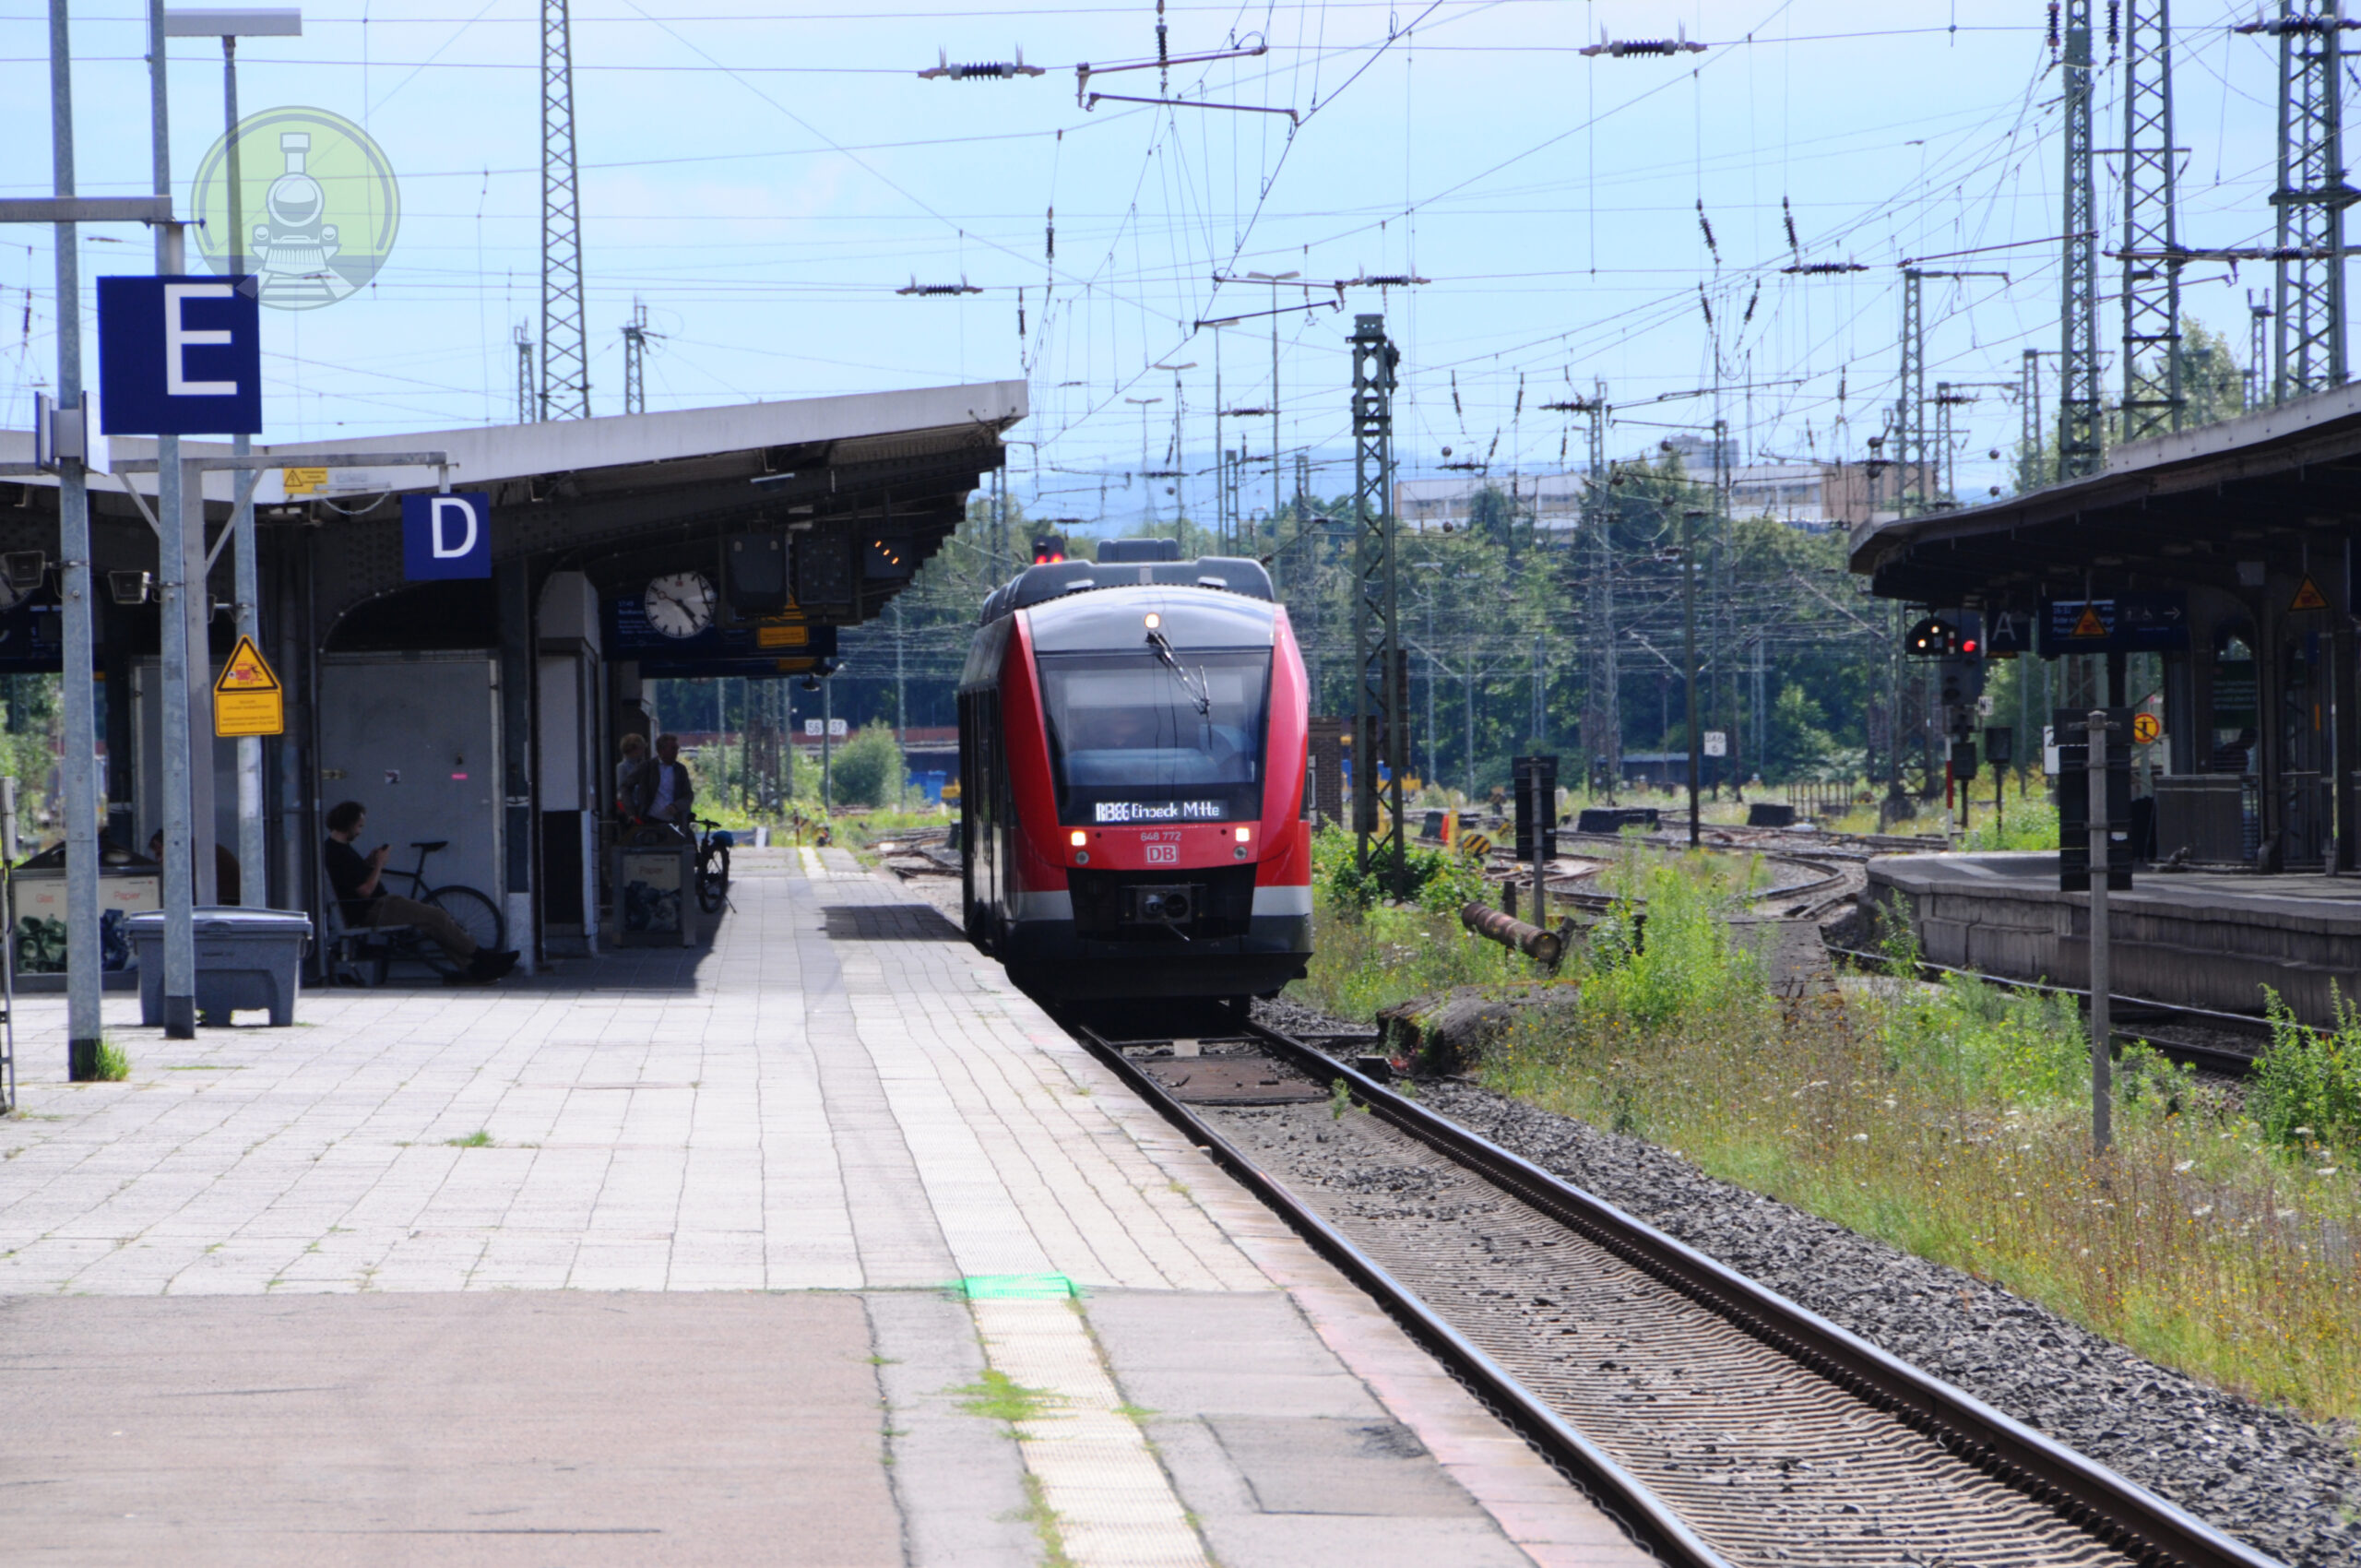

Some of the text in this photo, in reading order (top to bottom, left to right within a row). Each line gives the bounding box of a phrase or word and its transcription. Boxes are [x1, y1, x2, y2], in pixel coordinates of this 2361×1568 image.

[162, 283, 238, 397] E
[430, 496, 479, 560] D
[1991, 611, 2017, 642] A
[1183, 801, 1221, 819] Mtte
[1140, 831, 1181, 842] 648 772
[1148, 846, 1176, 861] DB
[113, 890, 141, 901] Papier
